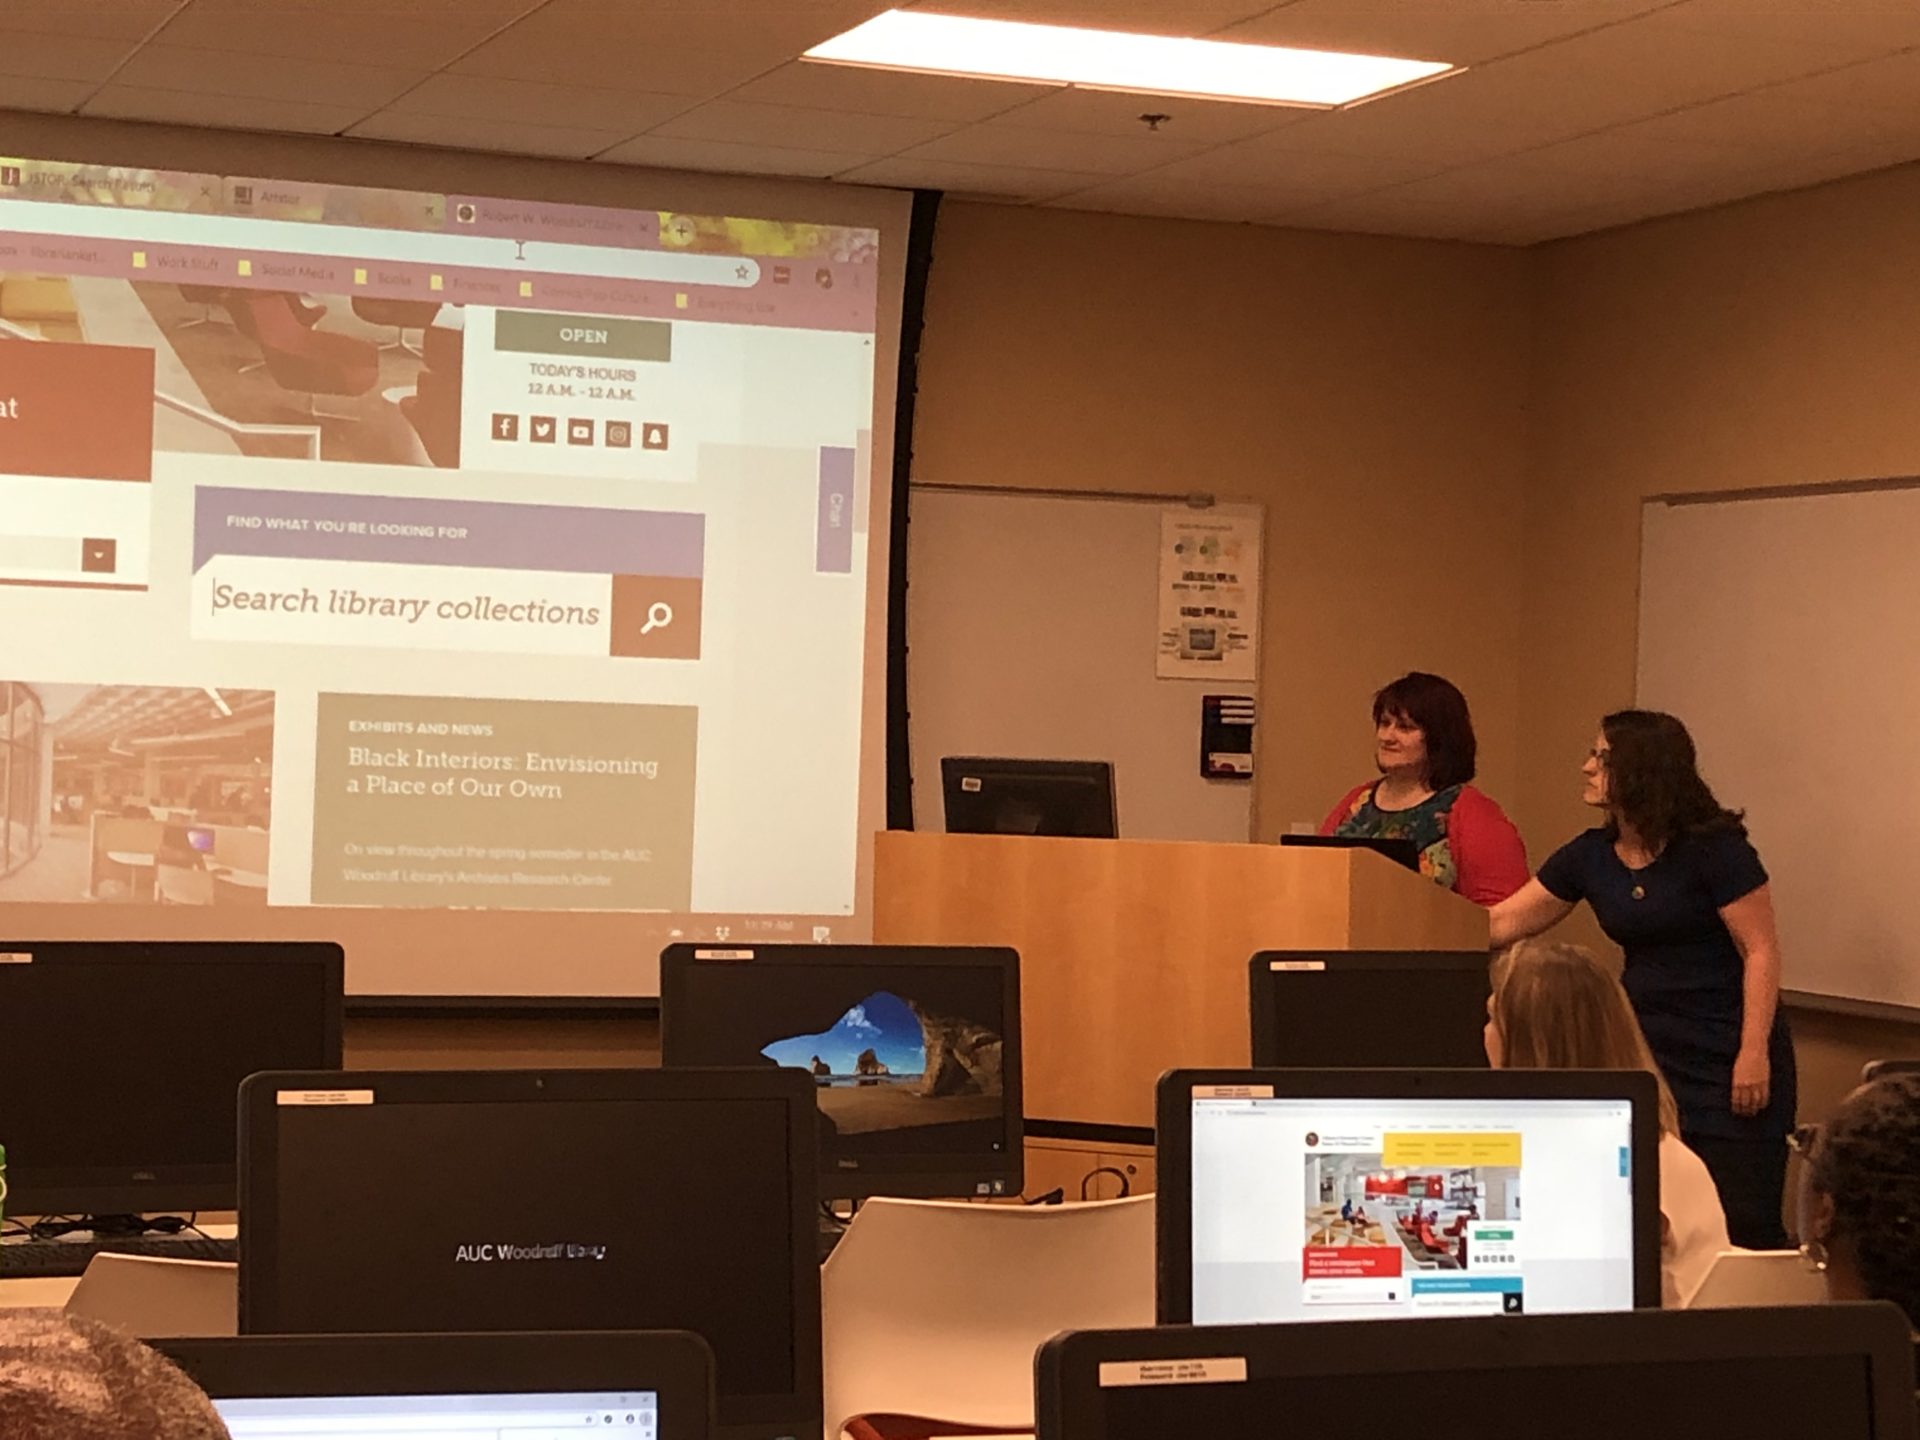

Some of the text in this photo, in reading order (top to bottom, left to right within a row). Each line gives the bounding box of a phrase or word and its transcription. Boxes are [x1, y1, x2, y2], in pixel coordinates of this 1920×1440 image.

[156, 255, 219, 271] Work Stuff
[262, 262, 335, 280] Social Media
[559, 328, 608, 344] OPEN
[529, 362, 637, 382] TODAY'S HOURS
[528, 382, 543, 395] 12
[546, 384, 575, 396] A.M.
[589, 387, 603, 399] 12
[606, 388, 636, 400] A.M.
[226, 515, 468, 539] FIND WHAT YOU'RE LOOKING FOR
[213, 584, 600, 626] Search library collections
[348, 720, 493, 737] EXHIBITS AND NEWS
[348, 746, 409, 768] Black
[525, 752, 659, 779] Envisioning
[346, 774, 563, 799] a Place of Our Own
[344, 842, 361, 857] On
[365, 843, 395, 857] view
[398, 843, 466, 862] throughout
[487, 846, 526, 863] spring
[455, 1243, 493, 1262] AUC
[497, 1242, 564, 1261] Woodruff
